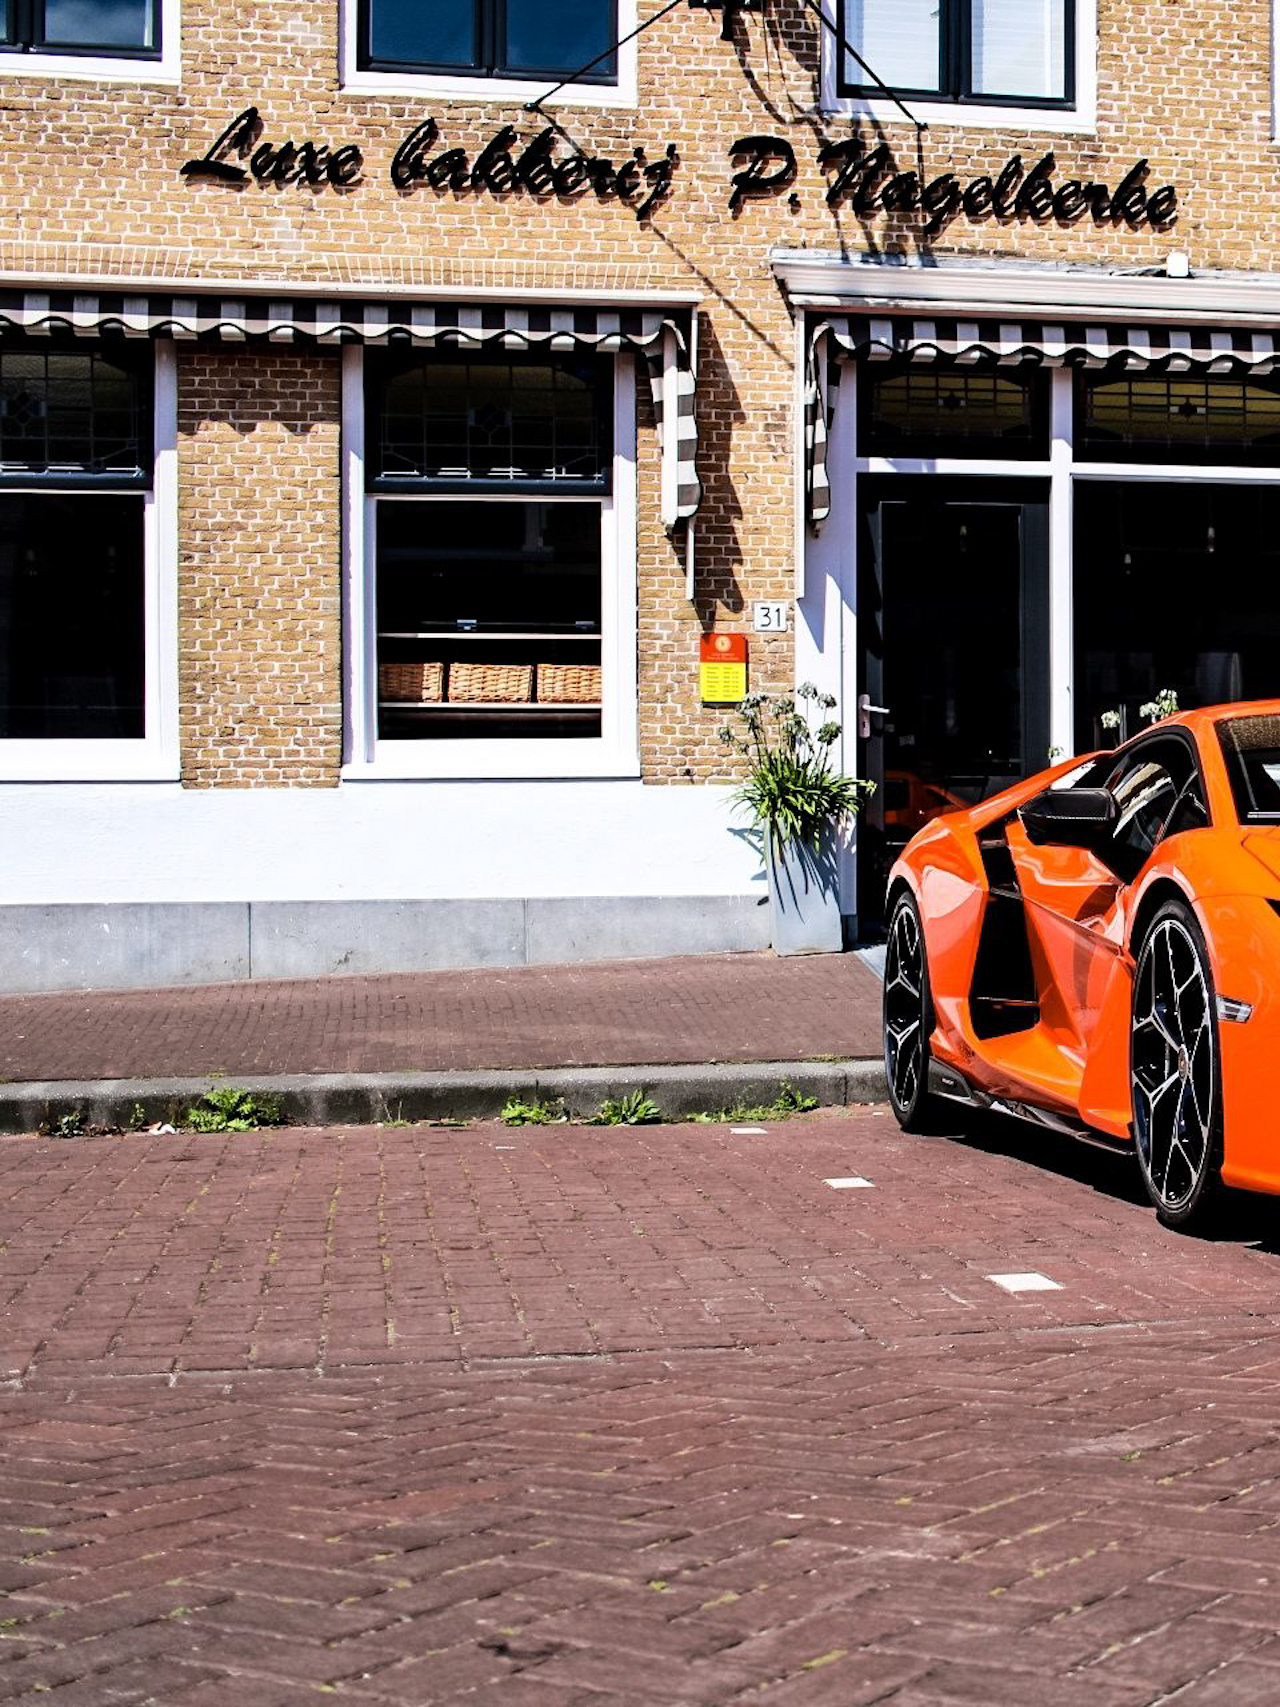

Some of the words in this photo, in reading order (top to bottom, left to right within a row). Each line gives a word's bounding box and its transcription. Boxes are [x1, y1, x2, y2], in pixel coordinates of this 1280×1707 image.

[180, 107, 363, 187] Luxe
[390, 117, 677, 220] bakkerij
[728, 135, 799, 211] P.
[817, 137, 1177, 236] Nagelkerke
[760, 607, 782, 627] 31
